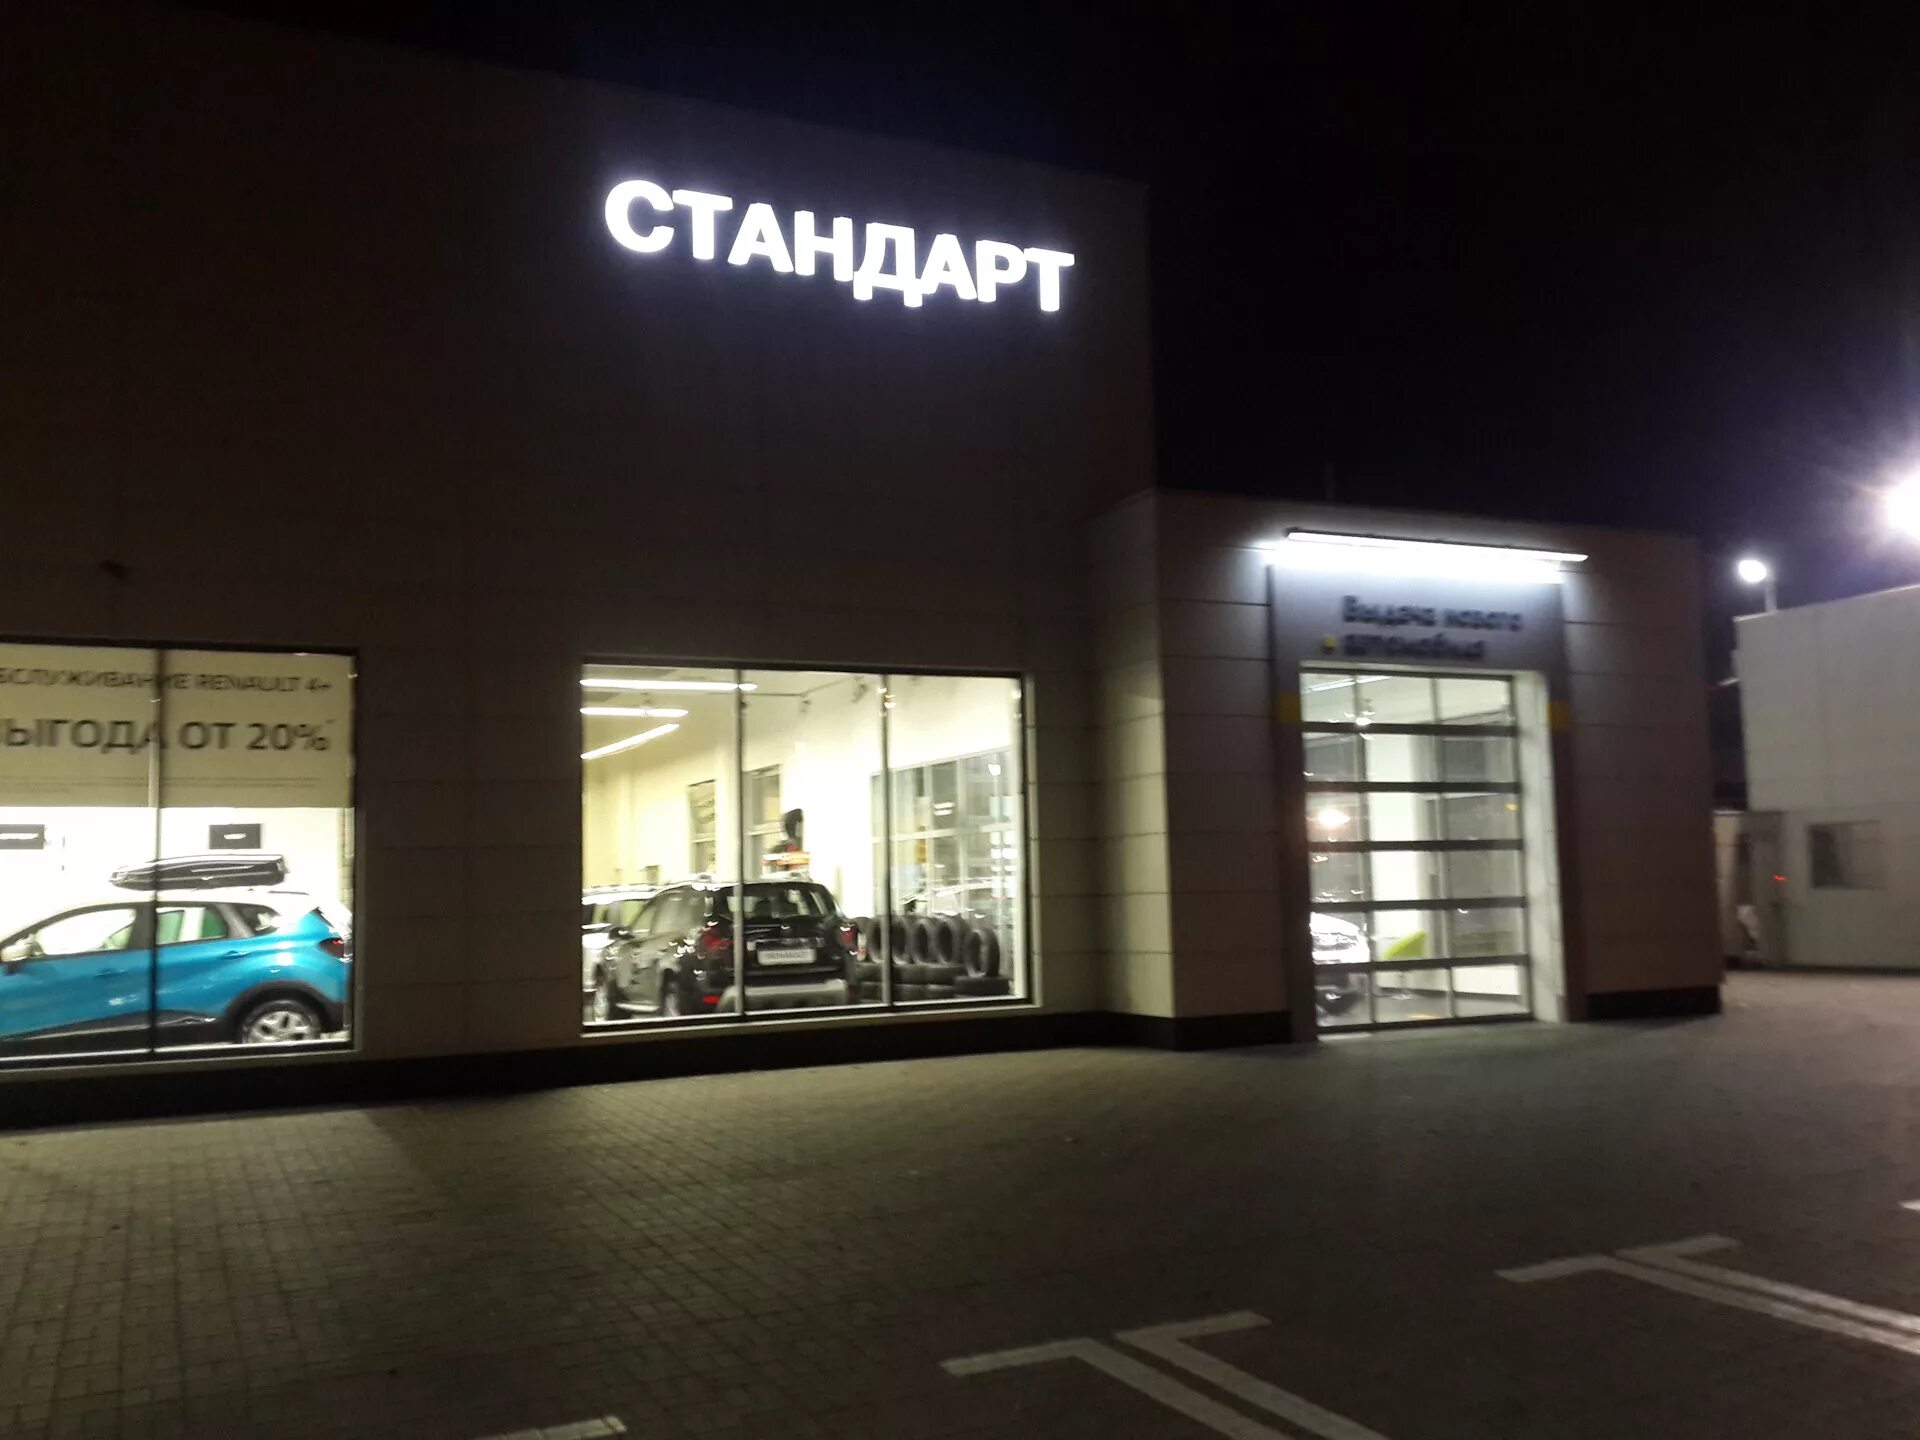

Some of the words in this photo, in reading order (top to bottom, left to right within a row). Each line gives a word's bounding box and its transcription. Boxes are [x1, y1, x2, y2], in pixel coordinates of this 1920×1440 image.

[605, 179, 1075, 312] СТАНДАРТ
[196, 673, 301, 692] RENAULT
[0, 718, 168, 754] ЫГОДА
[178, 720, 237, 751] ОТ
